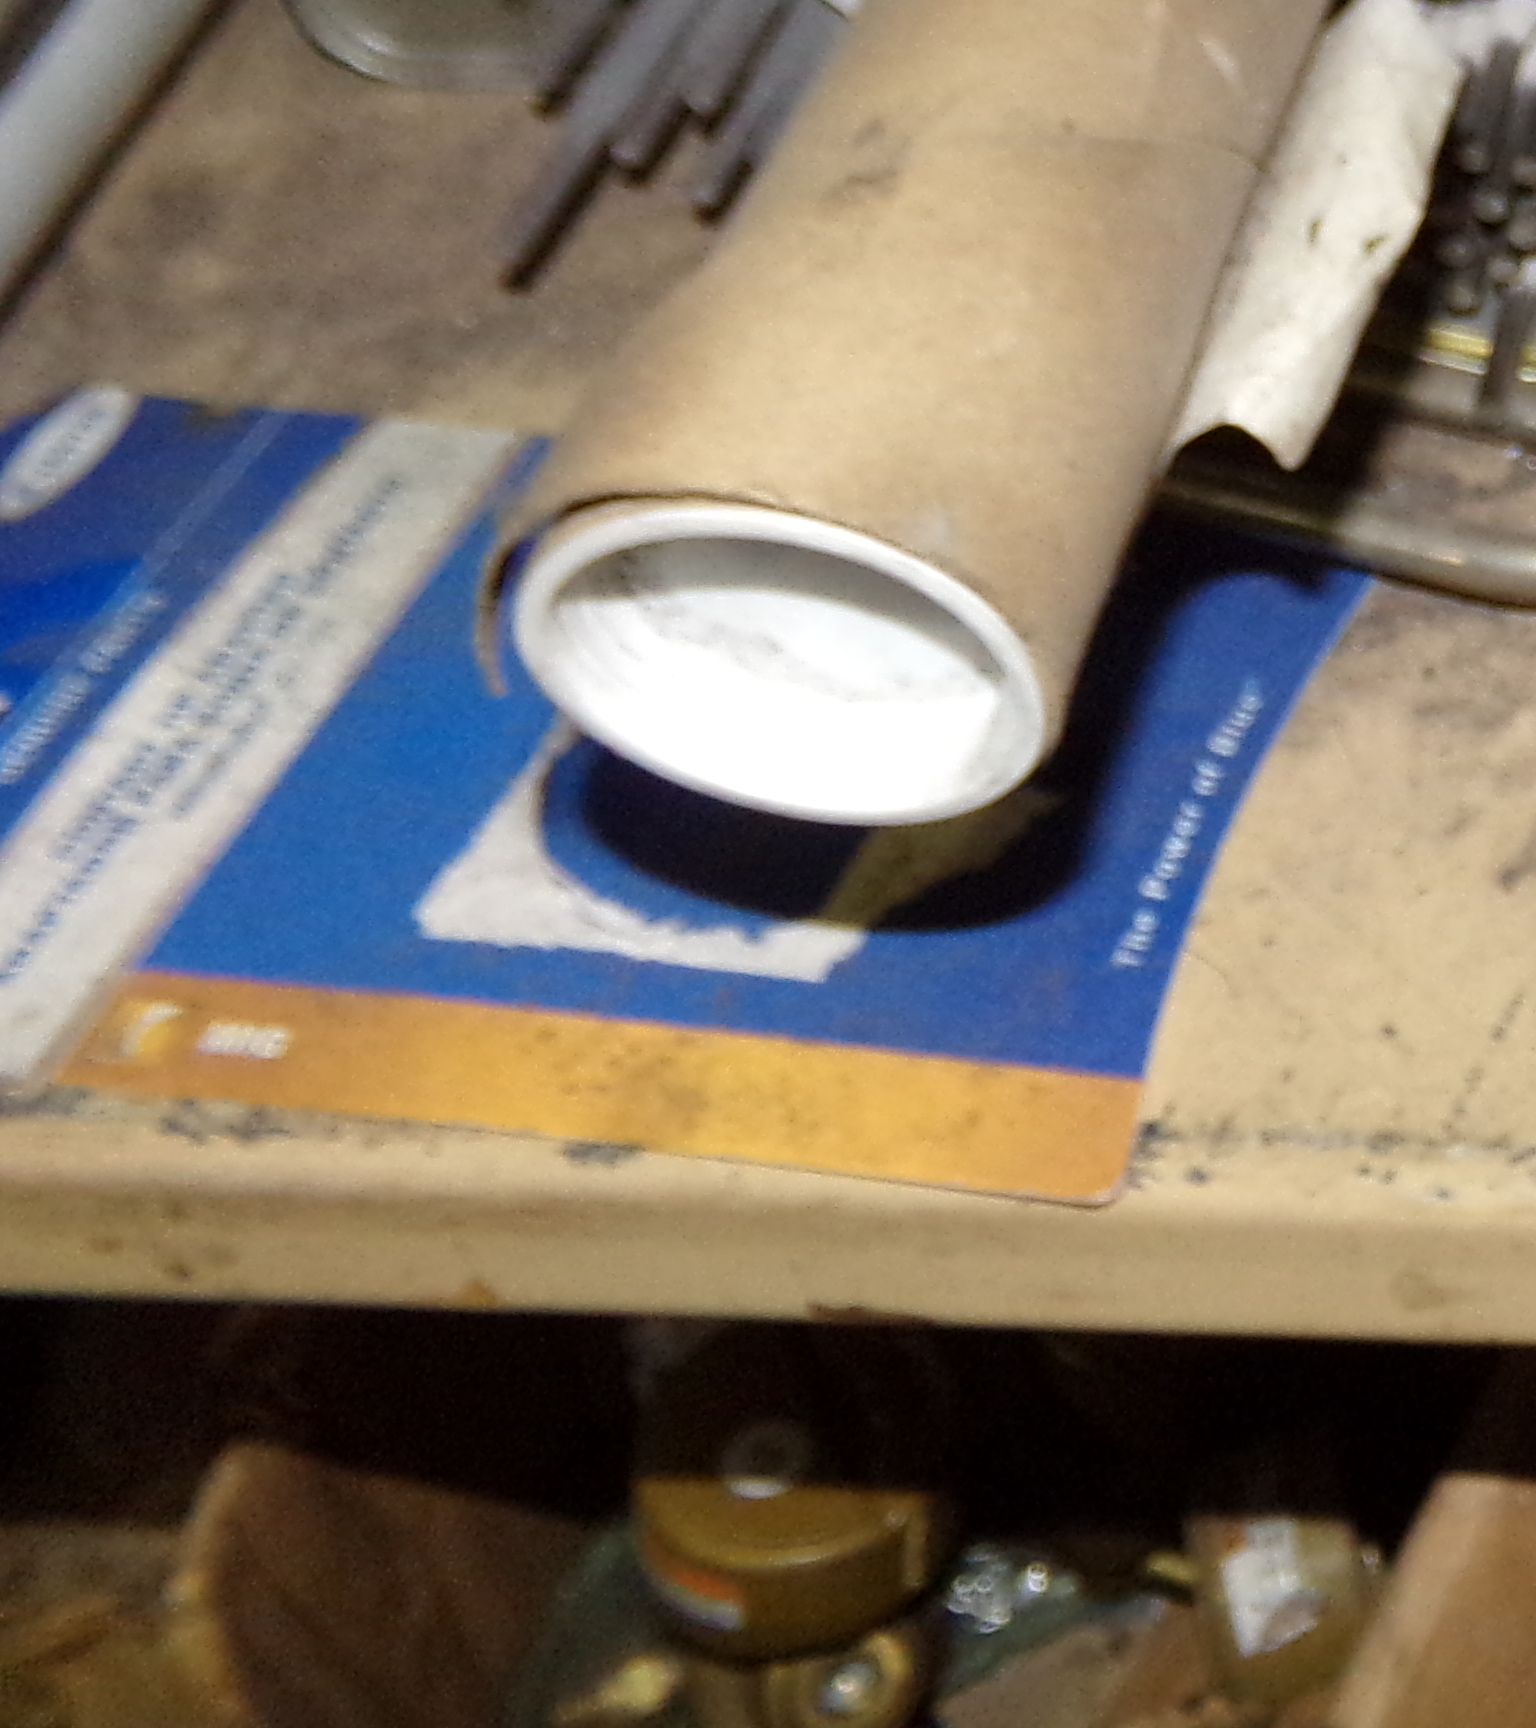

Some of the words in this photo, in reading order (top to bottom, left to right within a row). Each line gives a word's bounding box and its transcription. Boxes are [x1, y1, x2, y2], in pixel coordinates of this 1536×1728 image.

[1110, 907, 1160, 968] The
[1139, 802, 1199, 902] Power
[1191, 760, 1224, 797] of
